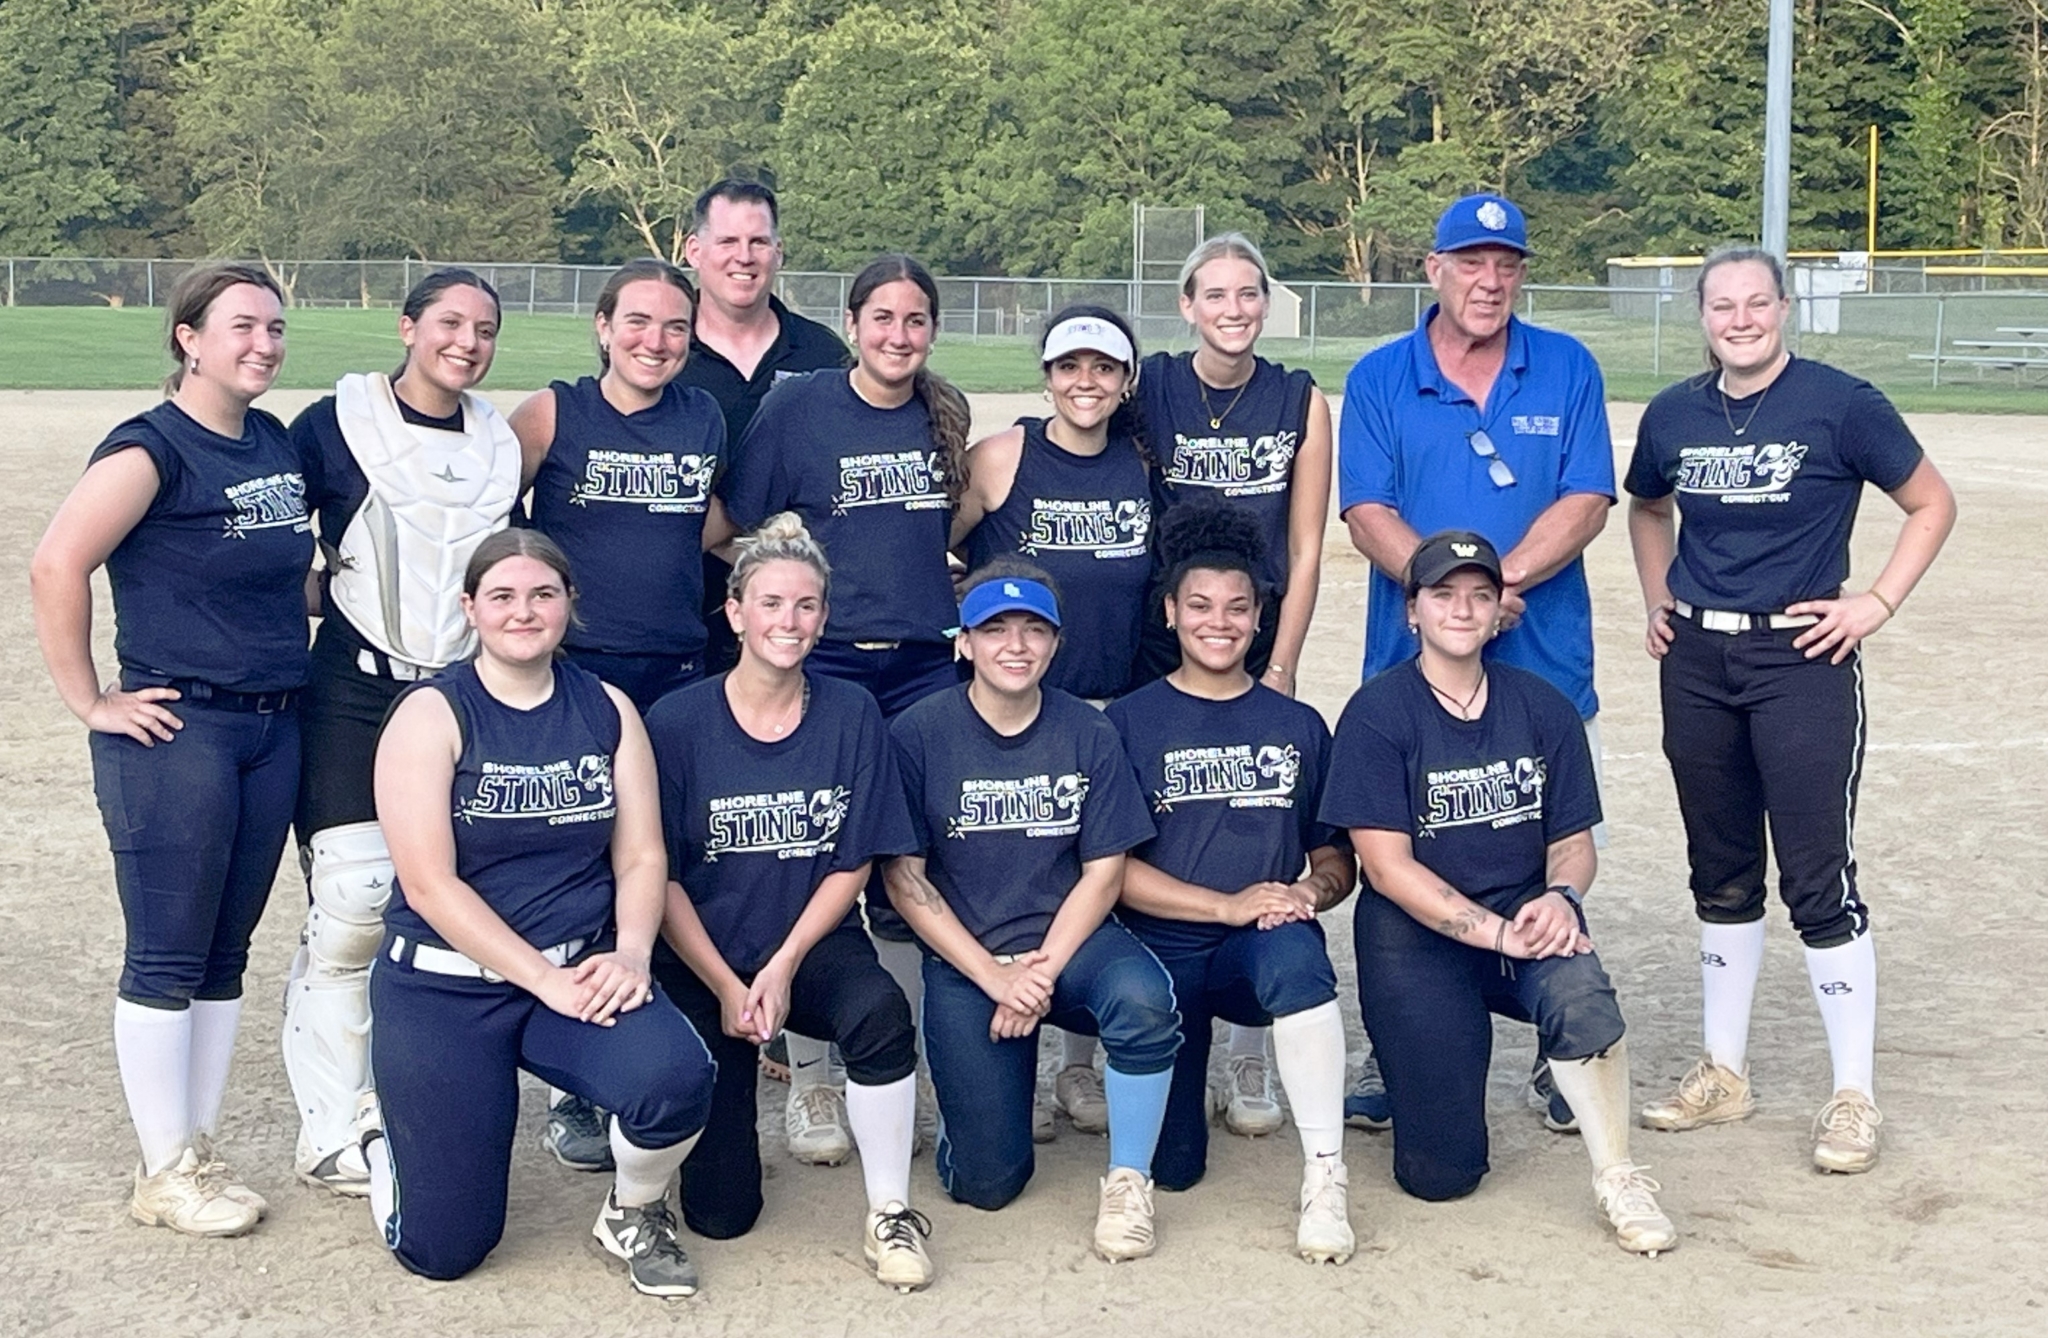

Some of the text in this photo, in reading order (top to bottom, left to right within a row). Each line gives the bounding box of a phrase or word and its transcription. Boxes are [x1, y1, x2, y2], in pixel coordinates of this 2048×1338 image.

[588, 449, 675, 465] SHORELINE
[840, 450, 923, 469] SHORELINE
[1171, 445, 1251, 481] STING
[1679, 444, 1756, 458] SHORELINE
[585, 461, 678, 497] STING
[841, 461, 930, 503] STING
[1676, 455, 1754, 488] STING
[1033, 498, 1112, 512] SHORELINE
[1031, 510, 1117, 544] STING
[482, 760, 573, 775] SHORELINE
[1164, 745, 1252, 763] SHORELINE
[962, 775, 1050, 792] SHORELINE
[1162, 756, 1257, 798] STING
[1427, 761, 1510, 785] SHORELINE
[472, 770, 581, 812] STING
[709, 791, 806, 812] SHORELINE
[960, 787, 1054, 826] STING
[1427, 772, 1517, 823] STING
[708, 804, 807, 849] STING
